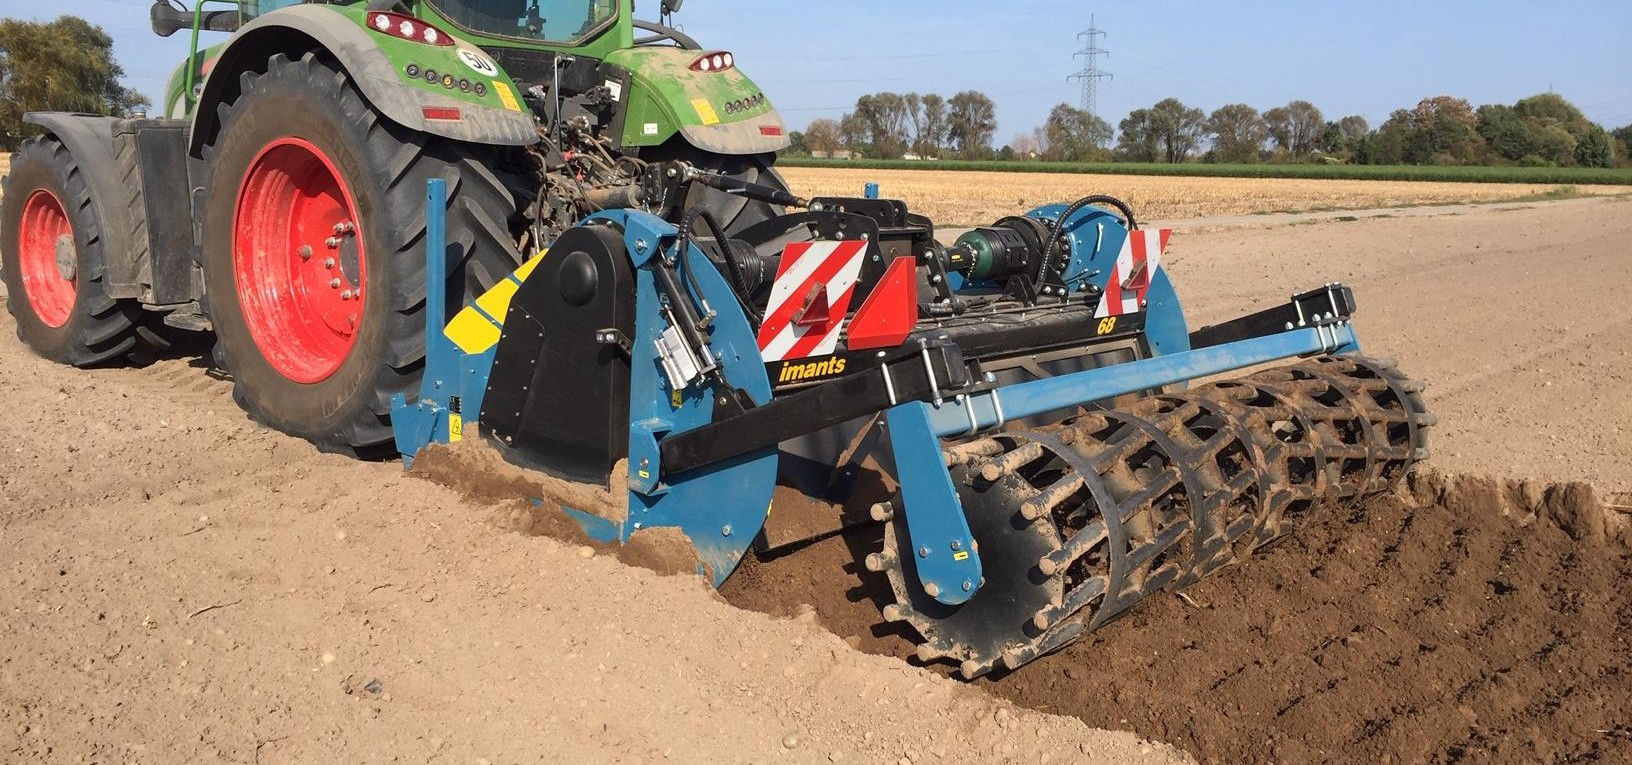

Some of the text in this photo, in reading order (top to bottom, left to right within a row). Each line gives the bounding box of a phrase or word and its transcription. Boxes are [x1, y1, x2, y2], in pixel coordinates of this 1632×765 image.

[461, 51, 492, 71] 50
[1097, 316, 1117, 335] 68
[779, 356, 846, 382] imants
